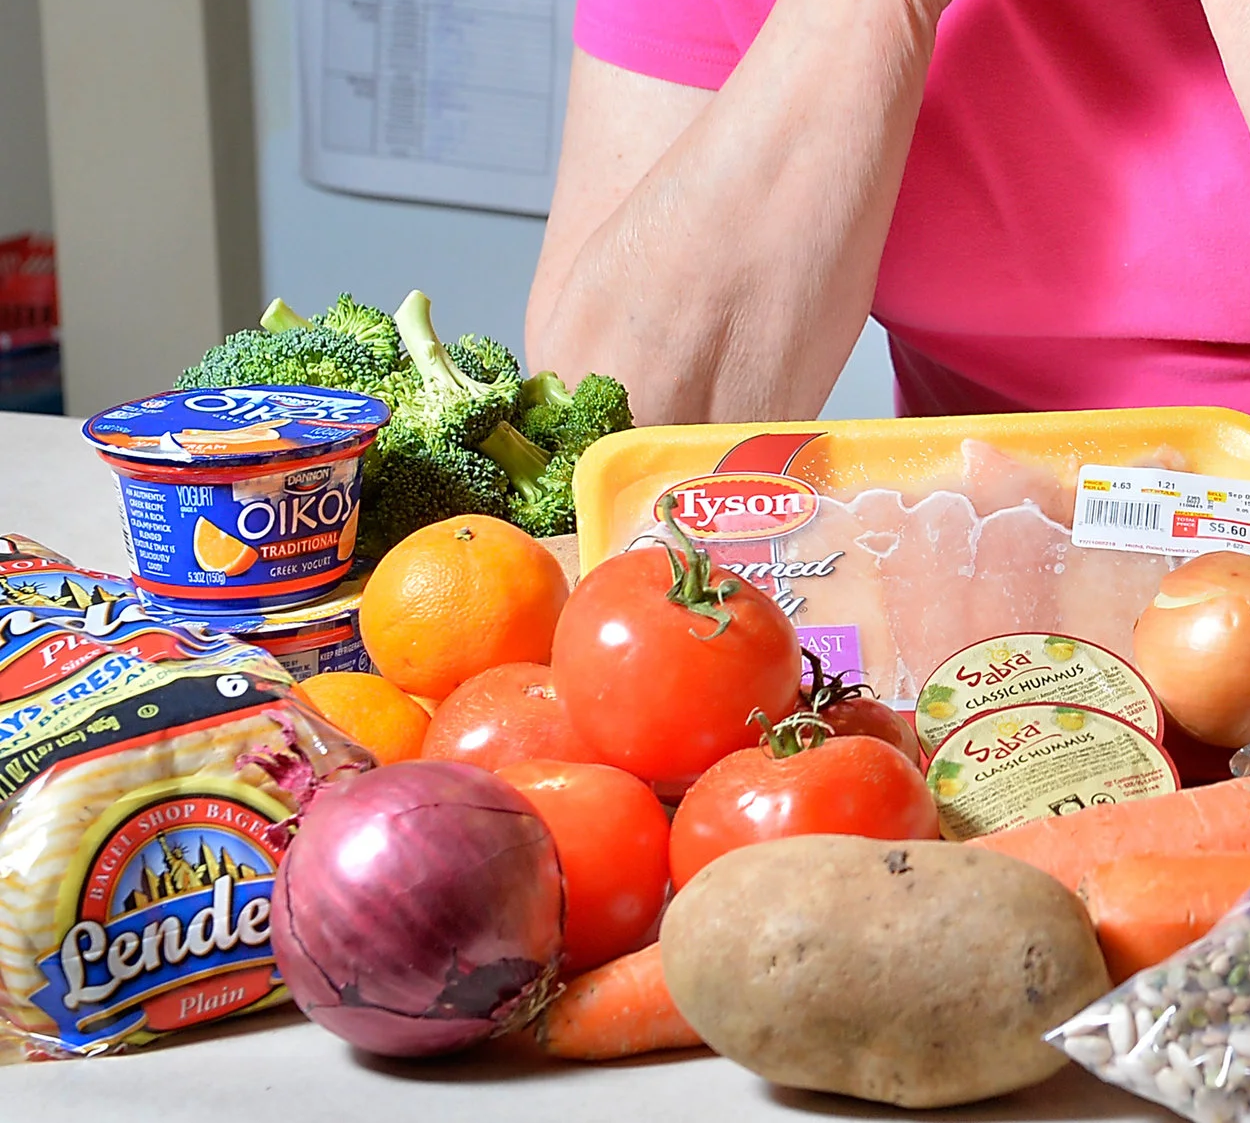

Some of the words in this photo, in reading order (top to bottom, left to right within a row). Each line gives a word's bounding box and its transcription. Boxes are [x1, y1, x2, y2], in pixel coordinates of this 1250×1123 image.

[184, 394, 360, 422] OIKOS
[270, 394, 321, 407] DANNON
[184, 443, 227, 451] REAM
[287, 468, 330, 486] DANNON
[1158, 481, 1175, 490] 1.21
[177, 485, 214, 507] YOGURT
[673, 489, 803, 527] Tyson
[237, 482, 353, 540] OIKOS
[1209, 522, 1247, 537] $5.60
[260, 534, 338, 559] TRADITIONAL
[206, 572, 226, 585] (150g)
[270, 564, 298, 578] GREEK
[302, 556, 331, 573] YOGURT
[61, 648, 101, 674] Since
[320, 650, 334, 660] KEEP
[956, 653, 1031, 687] Sabra
[216, 675, 249, 697] 6
[966, 685, 1018, 710] CLASSIC
[1019, 664, 1084, 691] HUMMUS
[964, 723, 1041, 762] Sabra
[974, 756, 1028, 782] CLASSIC
[1028, 732, 1095, 758] HUMMUS
[89, 836, 135, 901] BAGEL
[138, 804, 196, 834] SHOP
[179, 987, 245, 1020] Plain
